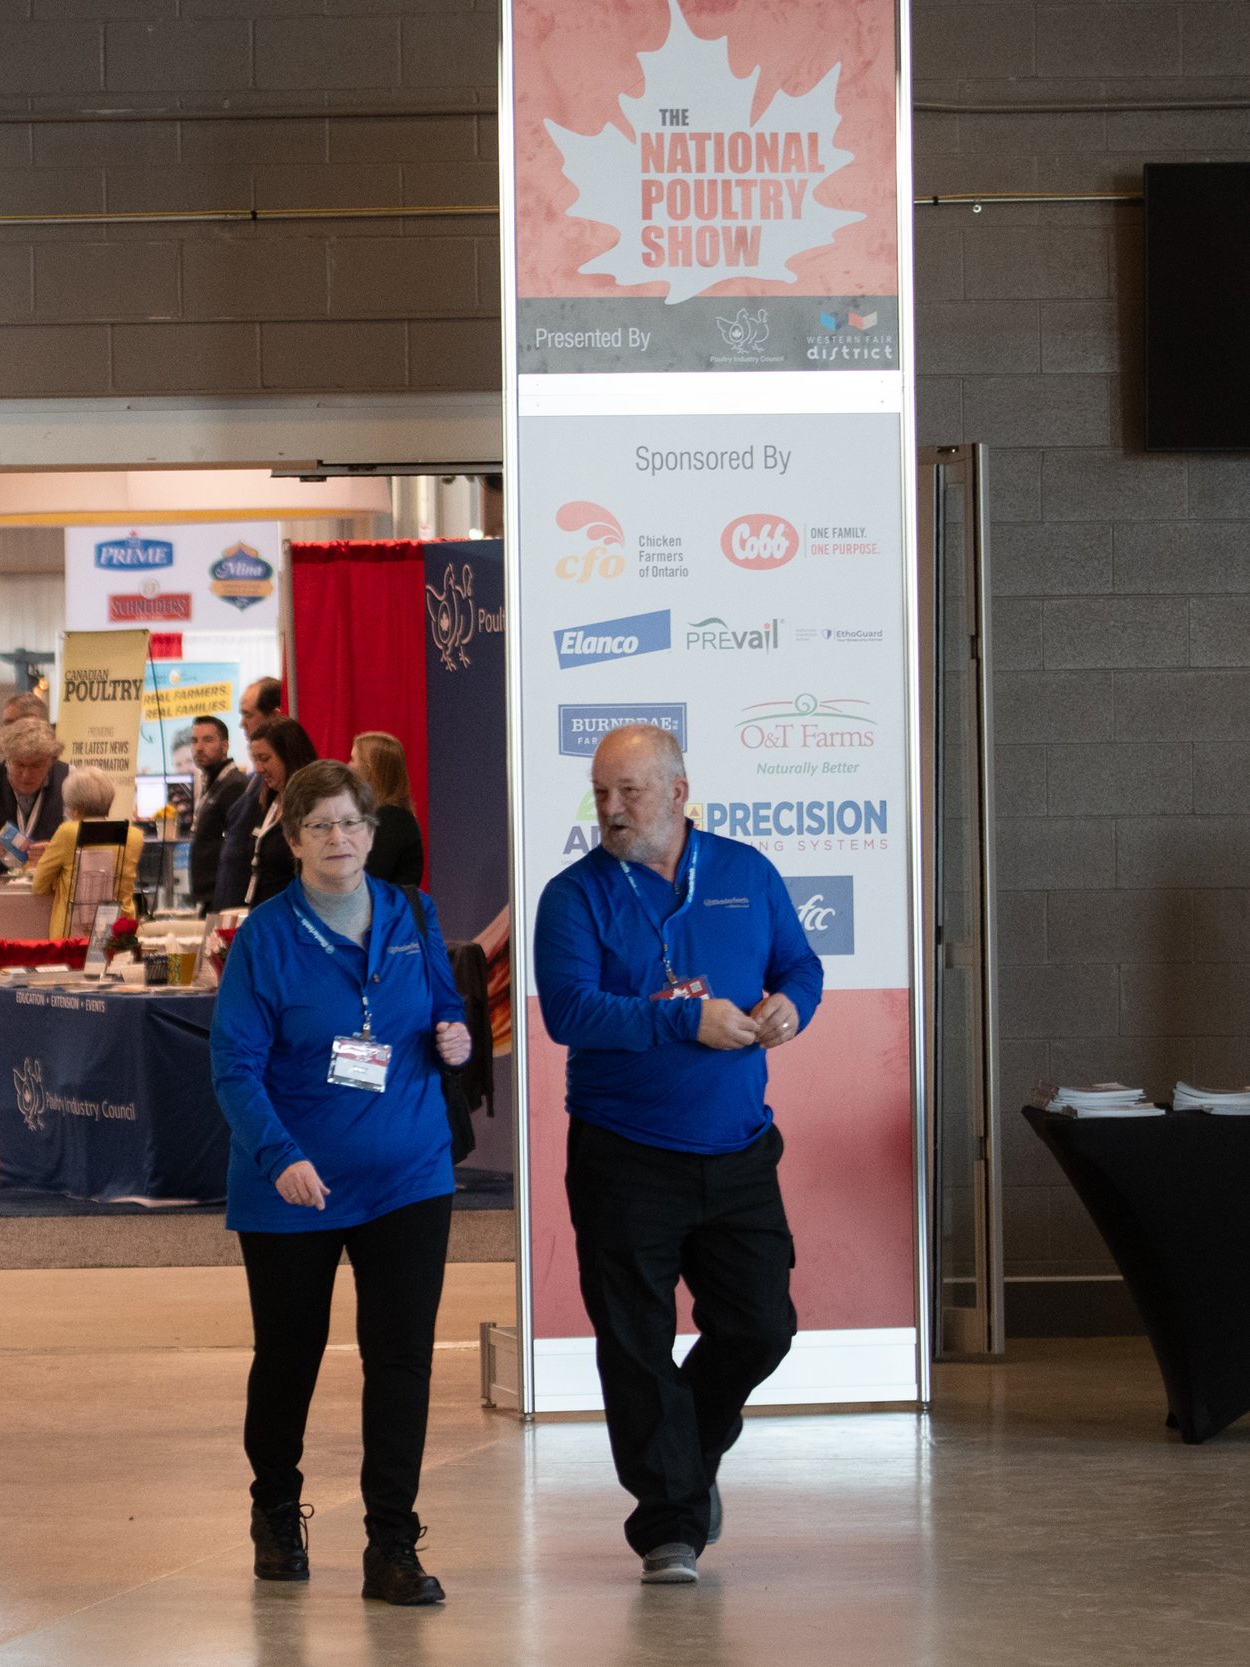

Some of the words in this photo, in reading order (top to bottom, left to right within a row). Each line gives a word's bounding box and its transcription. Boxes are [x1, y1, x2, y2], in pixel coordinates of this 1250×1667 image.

[659, 108, 690, 127] THE
[641, 131, 825, 174] NATIONAL
[641, 178, 808, 221] POULTRY
[641, 225, 762, 268] SHOW
[535, 327, 622, 349] Presented
[628, 328, 651, 352] By
[807, 336, 861, 344] WESTERN
[865, 335, 892, 344] FAIR
[807, 345, 893, 361] district
[635, 445, 755, 476] Sponsored
[763, 445, 792, 475] By
[639, 535, 682, 548] Chicken
[731, 523, 790, 561] Cobb
[810, 527, 829, 539] ONE
[832, 527, 867, 539] FAMILY.
[100, 548, 169, 564] PRIME
[639, 550, 684, 563] Farmers
[810, 543, 829, 555] ONE
[832, 543, 881, 555] PURPOSE.
[217, 562, 263, 578] Mina
[554, 546, 625, 584] cfo
[639, 565, 650, 578] of
[651, 565, 689, 578] Ontario
[560, 631, 639, 655] Elanco
[836, 630, 883, 638] EthoGuard
[65, 669, 109, 681] CANADIAN
[63, 679, 144, 702] POULTRY
[740, 724, 793, 749] O&T
[802, 724, 875, 748] Farms
[72, 741, 84, 755] THE
[85, 741, 109, 755] LATEST
[110, 741, 129, 755] NEWS
[757, 762, 818, 777] Naturally
[822, 762, 860, 774] Better
[707, 800, 888, 837] PRECISION
[798, 839, 888, 852] SYSTEMS
[798, 894, 836, 931] fcc
[16, 991, 45, 1006] EDUCATION
[51, 995, 80, 1010] EXTENSION
[85, 999, 105, 1013] EVENTS
[65, 1096, 99, 1121] Industry
[101, 1100, 136, 1121] Council
